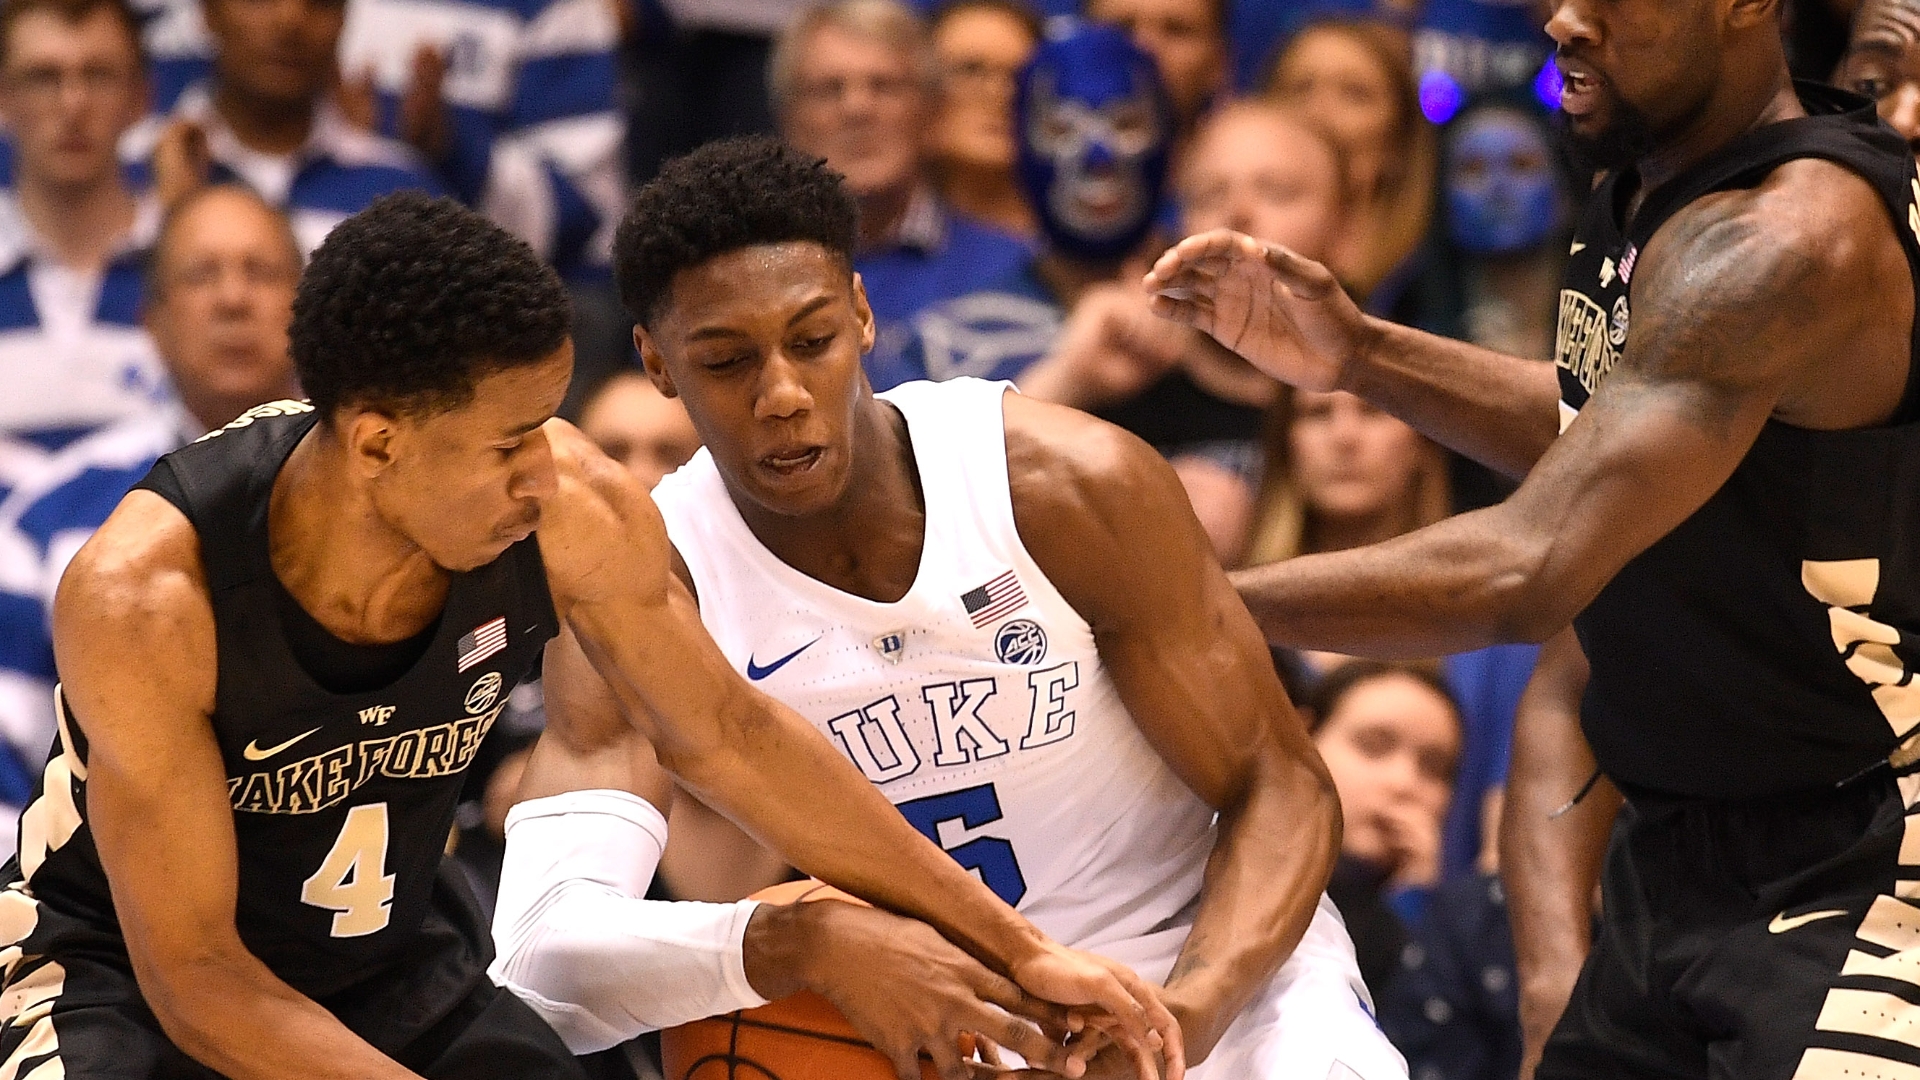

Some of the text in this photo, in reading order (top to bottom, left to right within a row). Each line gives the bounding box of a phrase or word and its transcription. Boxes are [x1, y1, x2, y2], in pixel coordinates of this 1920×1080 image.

[1003, 626, 1041, 657] ACC
[357, 704, 396, 727] WF
[827, 660, 1080, 785] UKE
[300, 801, 397, 938] 4
